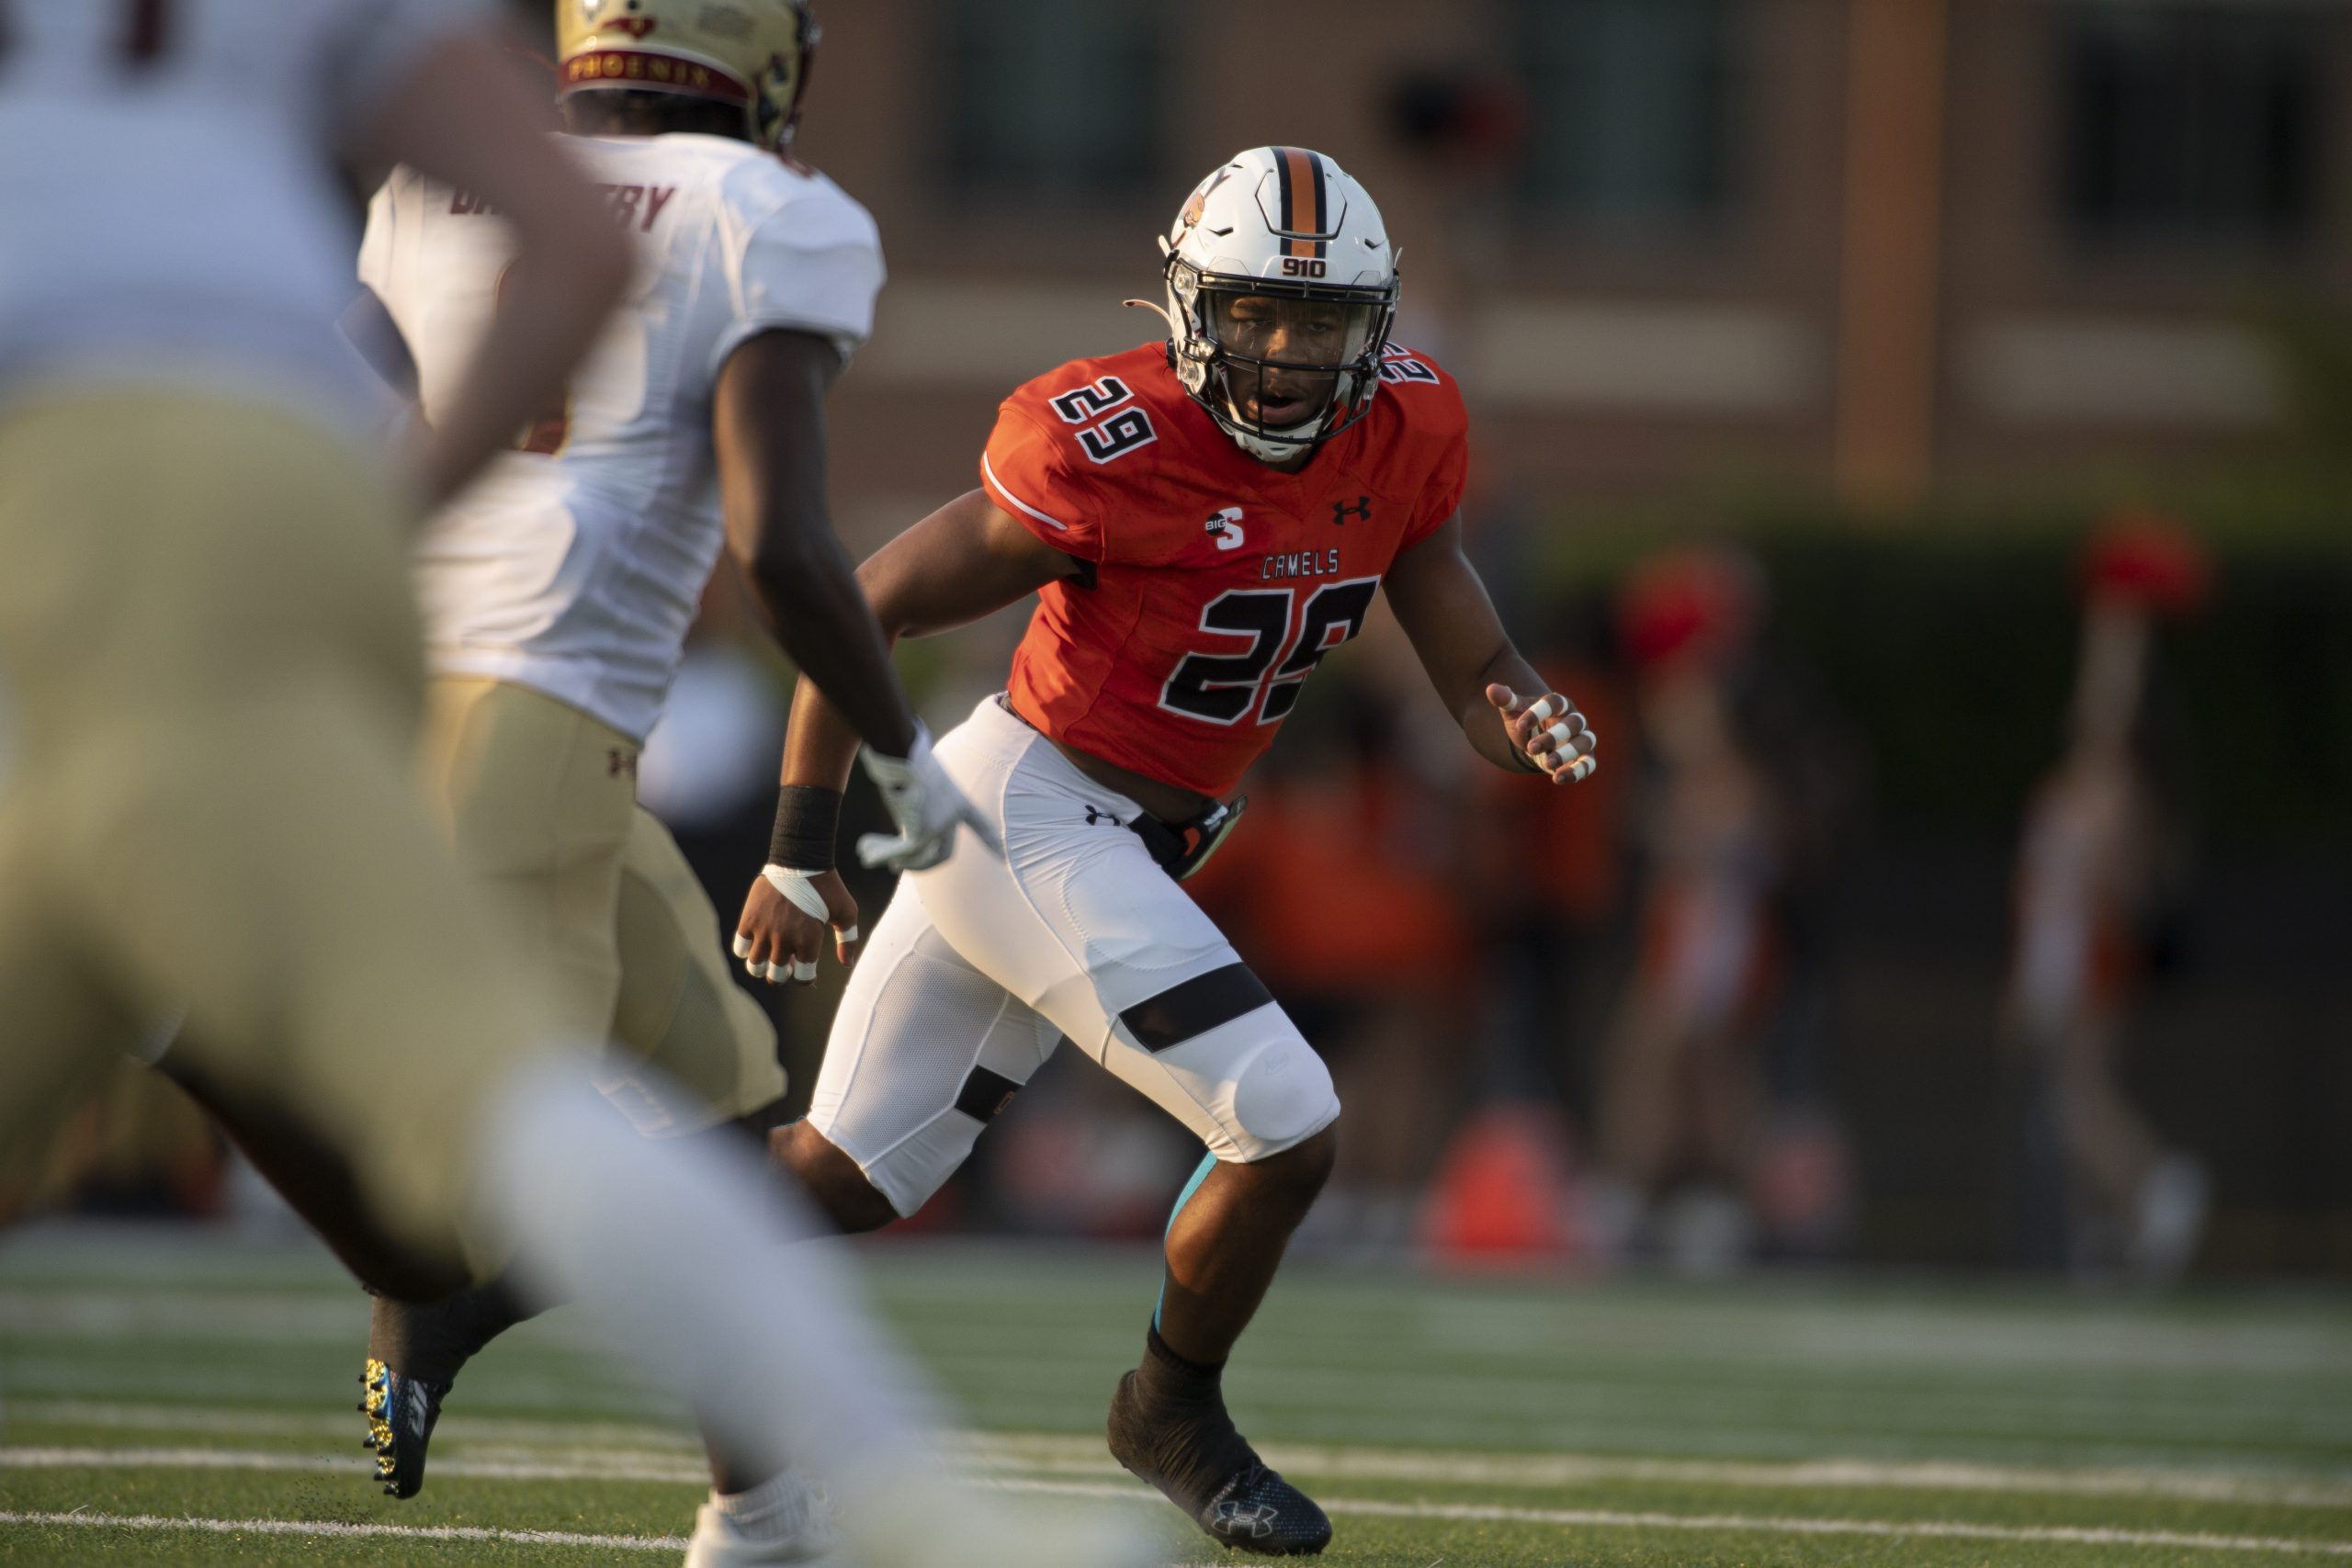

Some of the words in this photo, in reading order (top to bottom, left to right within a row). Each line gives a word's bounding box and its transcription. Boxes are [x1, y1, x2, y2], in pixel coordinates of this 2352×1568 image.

[1283, 257, 1326, 278] 910
[1047, 375, 1159, 465] 29
[1205, 518, 1227, 531] BIG
[1216, 506, 1244, 551] S
[1261, 548, 1339, 581] CAMELS
[1158, 574, 1382, 727] 29
